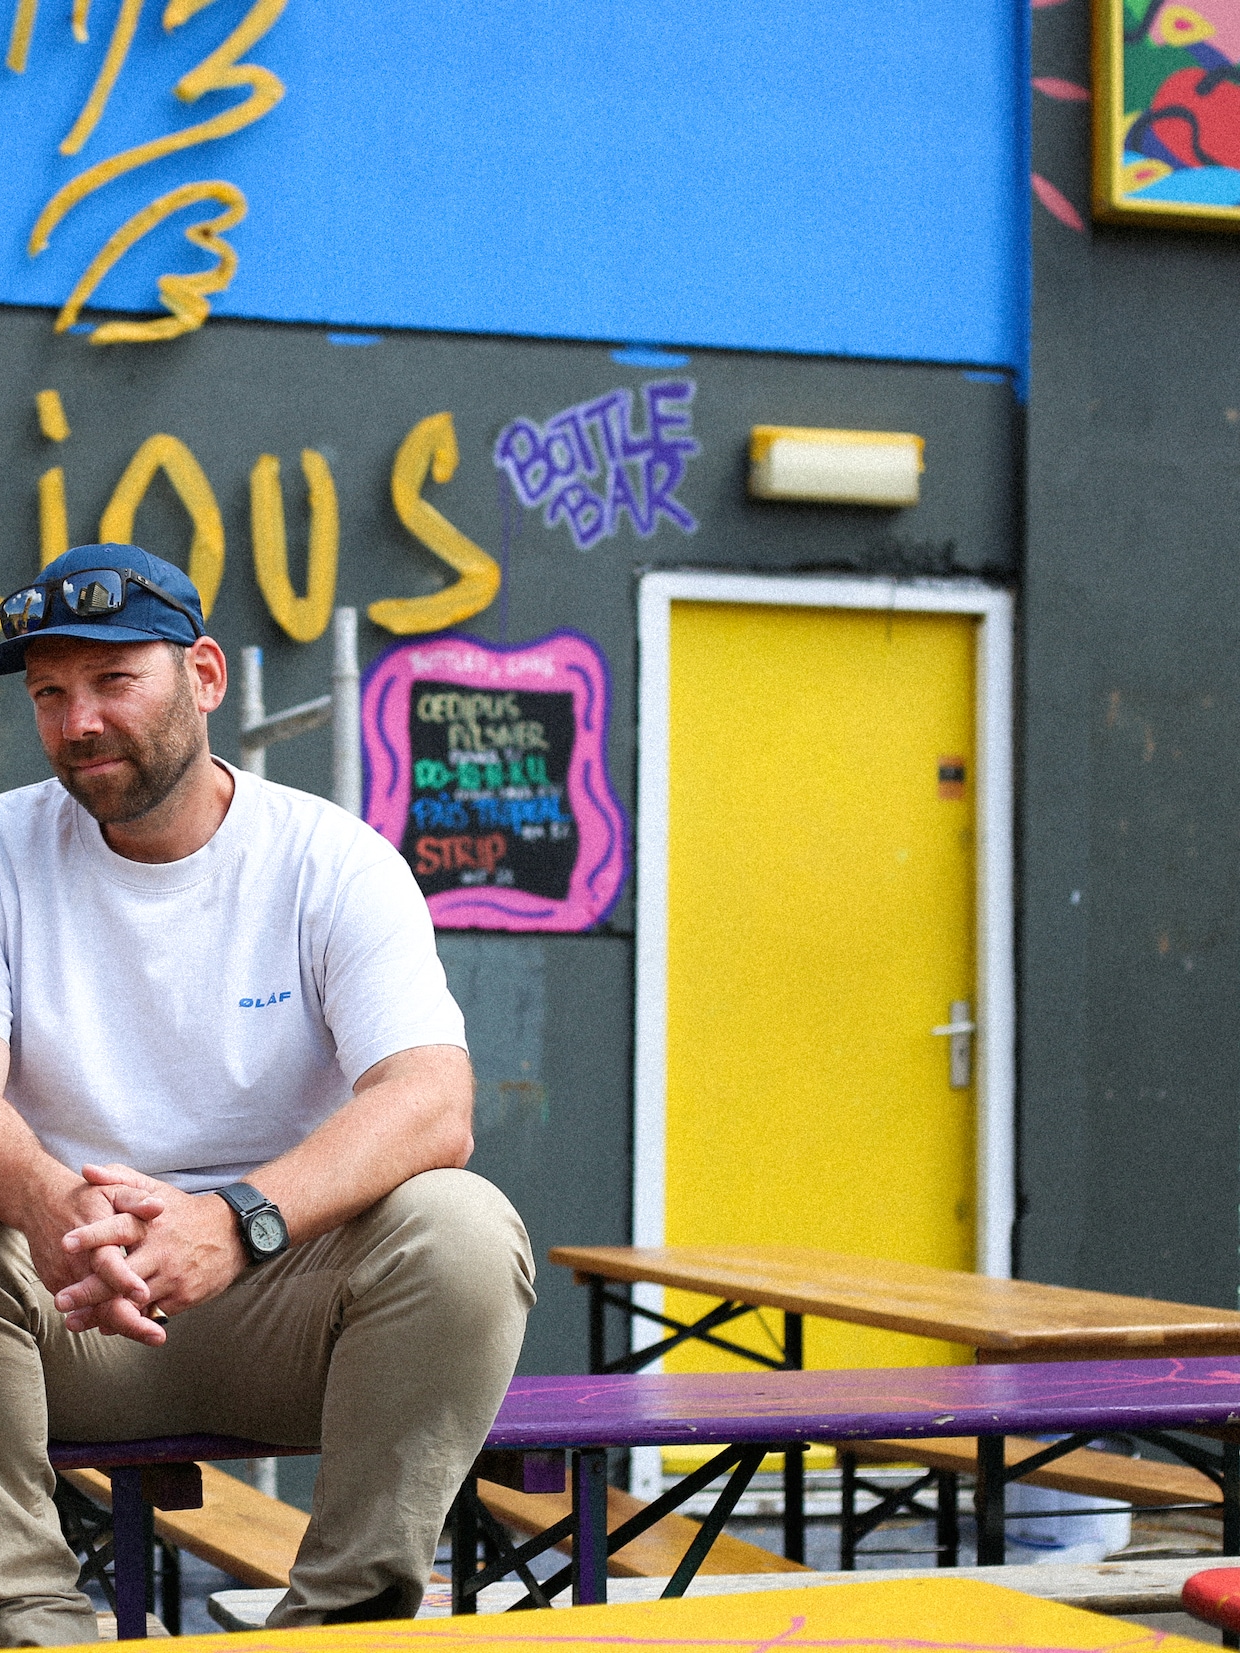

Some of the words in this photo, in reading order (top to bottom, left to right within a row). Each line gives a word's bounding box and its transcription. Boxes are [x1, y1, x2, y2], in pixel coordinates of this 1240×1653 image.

[493, 377, 702, 507] BOTTLE
[544, 450, 699, 549] BAR
[416, 832, 507, 876] STRIP
